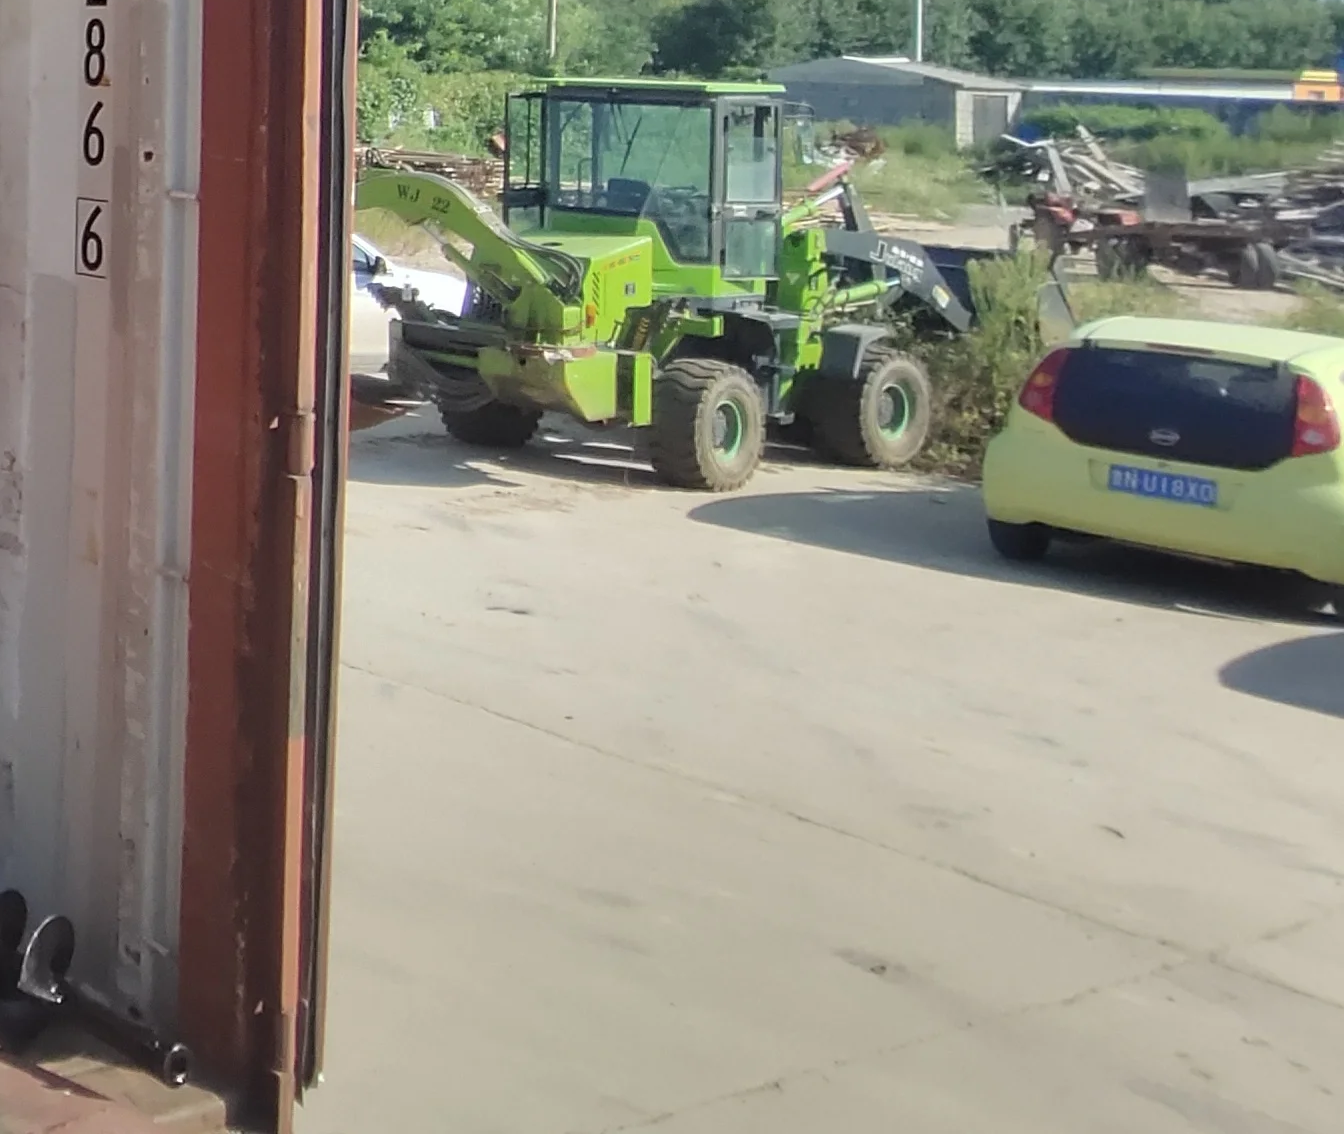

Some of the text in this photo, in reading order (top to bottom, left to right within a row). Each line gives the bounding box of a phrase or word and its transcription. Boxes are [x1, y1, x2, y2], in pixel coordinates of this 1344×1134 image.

[397, 184, 450, 214] WJ 22
[80, 204, 103, 271] 6
